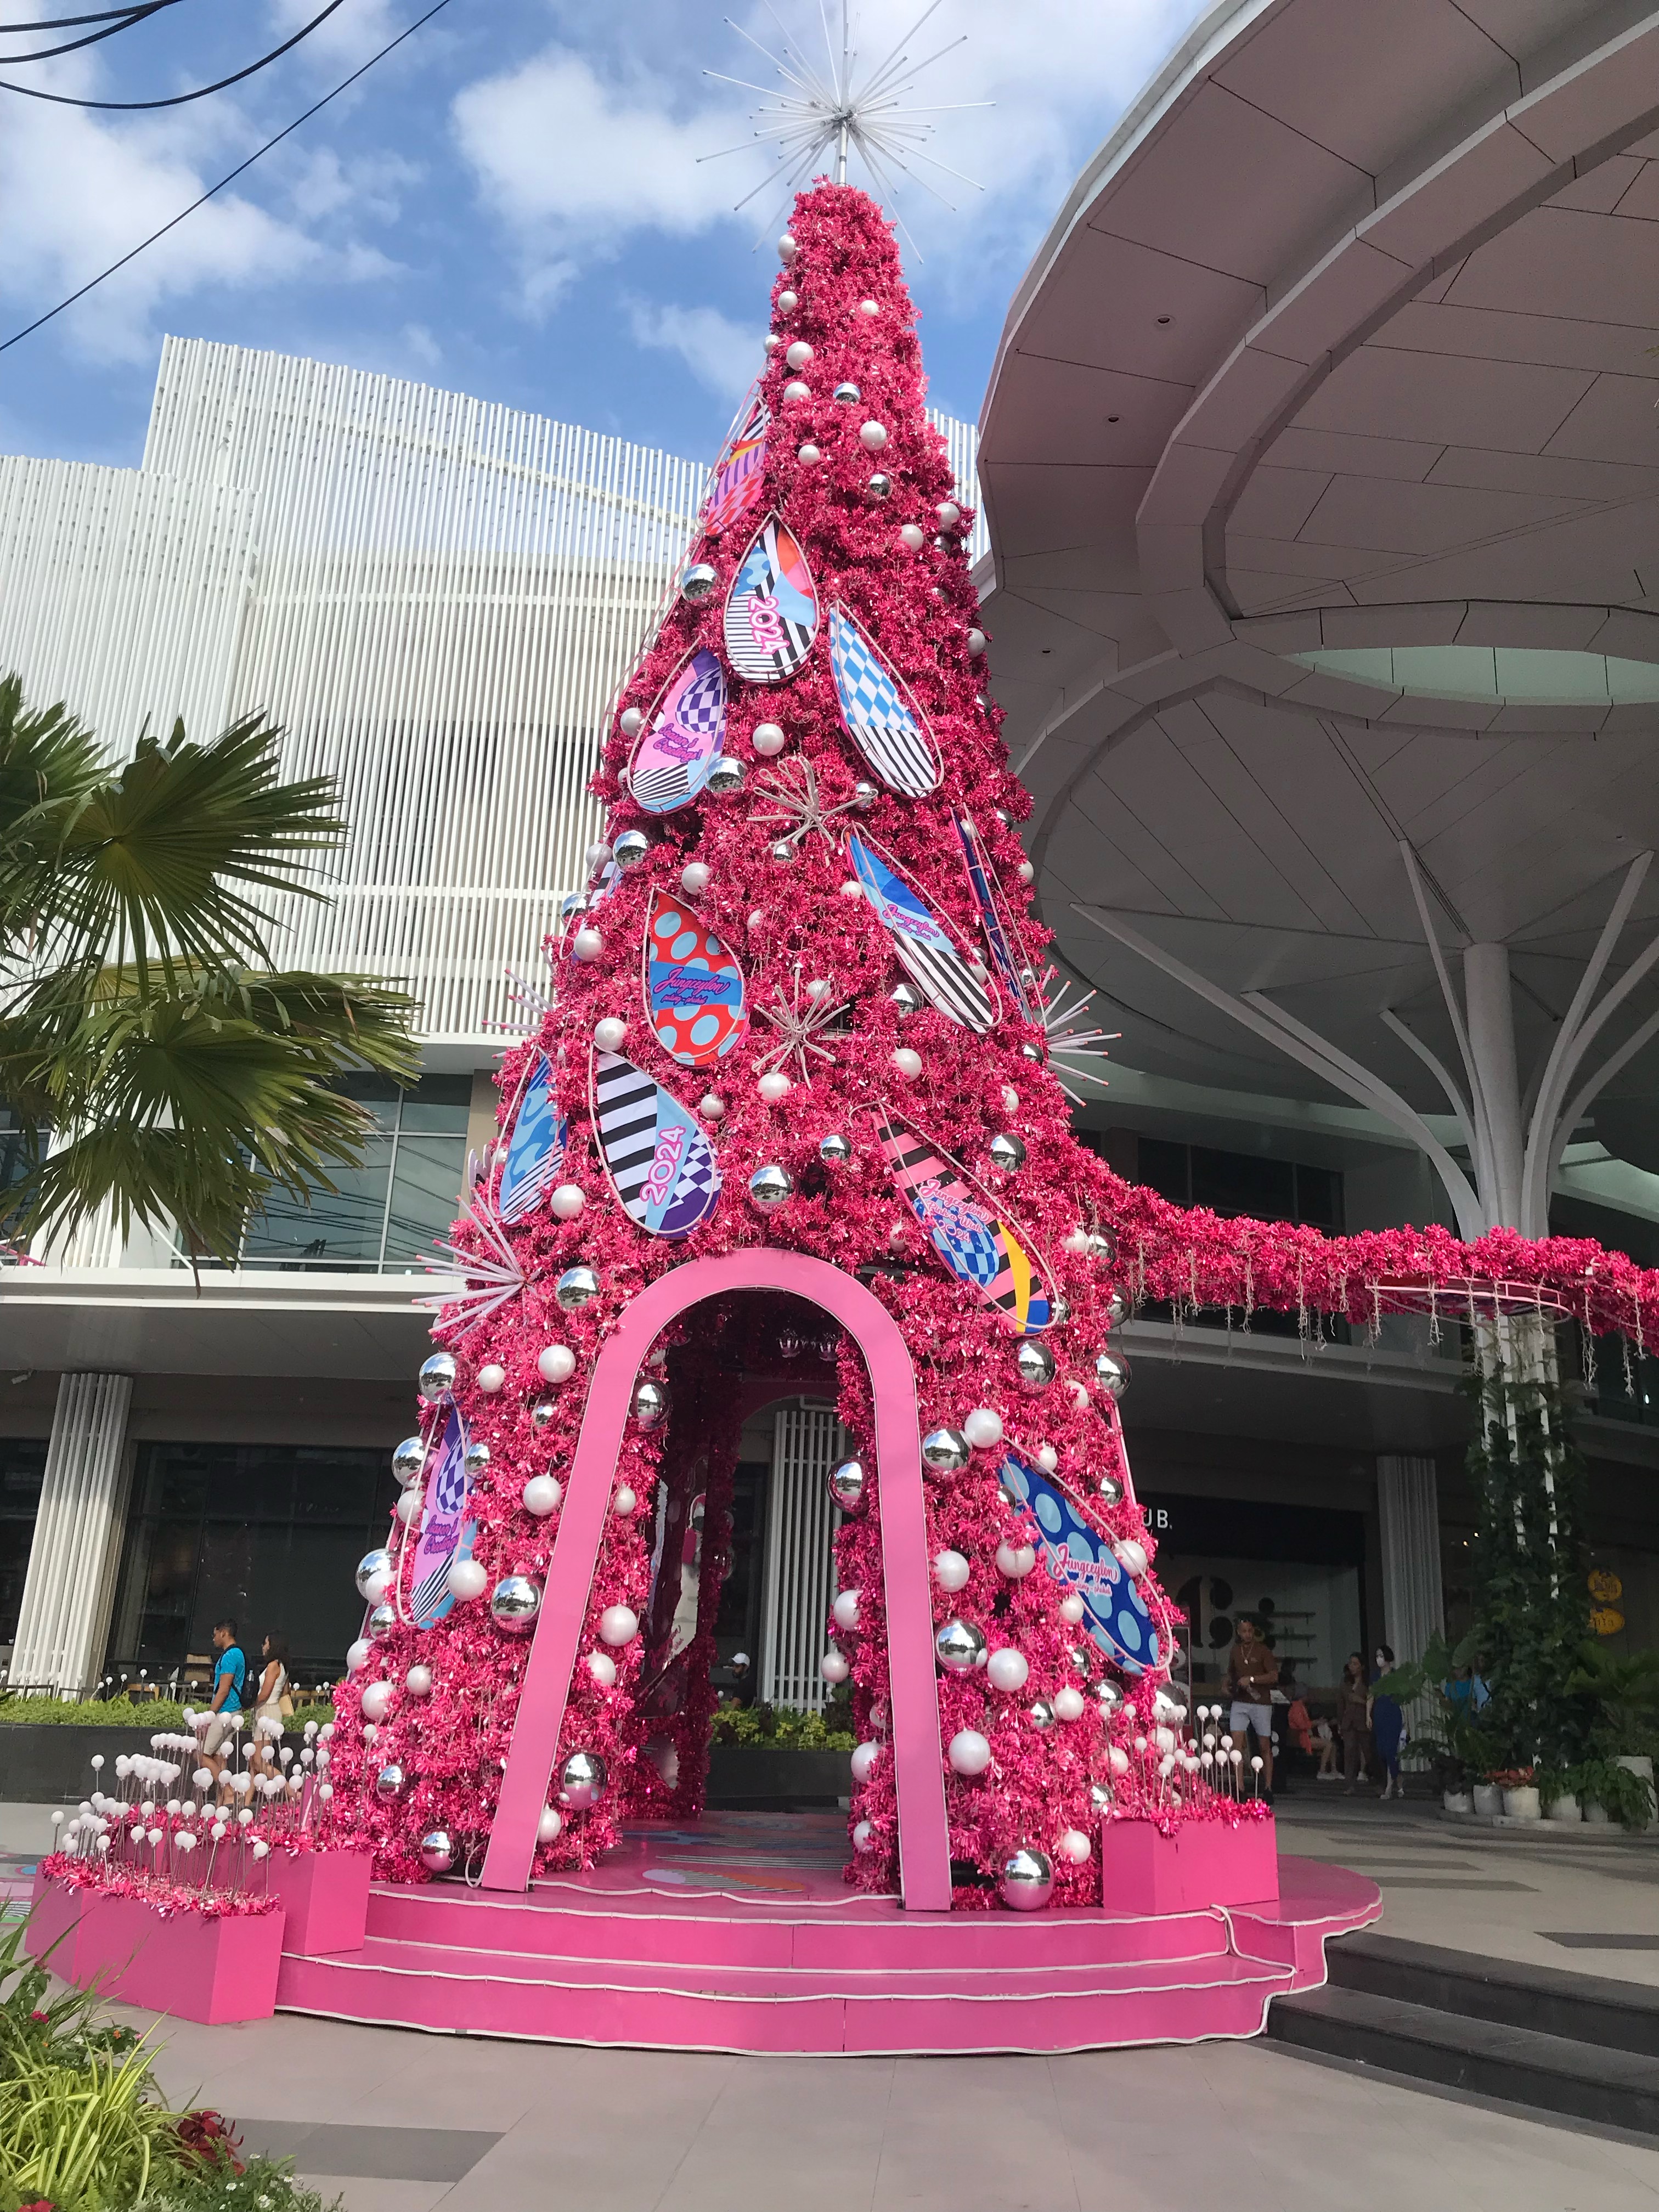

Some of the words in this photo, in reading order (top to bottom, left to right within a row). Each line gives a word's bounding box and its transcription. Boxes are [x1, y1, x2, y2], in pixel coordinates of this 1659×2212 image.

[748, 596, 790, 654] 2024
[653, 966, 731, 996] Jungceylon
[639, 1125, 686, 1207] 2024
[919, 1178, 990, 1222] Jungceylon
[926, 1200, 949, 1218] Pink
[957, 1214, 984, 1234] Wish
[938, 1220, 971, 1244] 2024
[1052, 1543, 1119, 1583] Jungceylon
